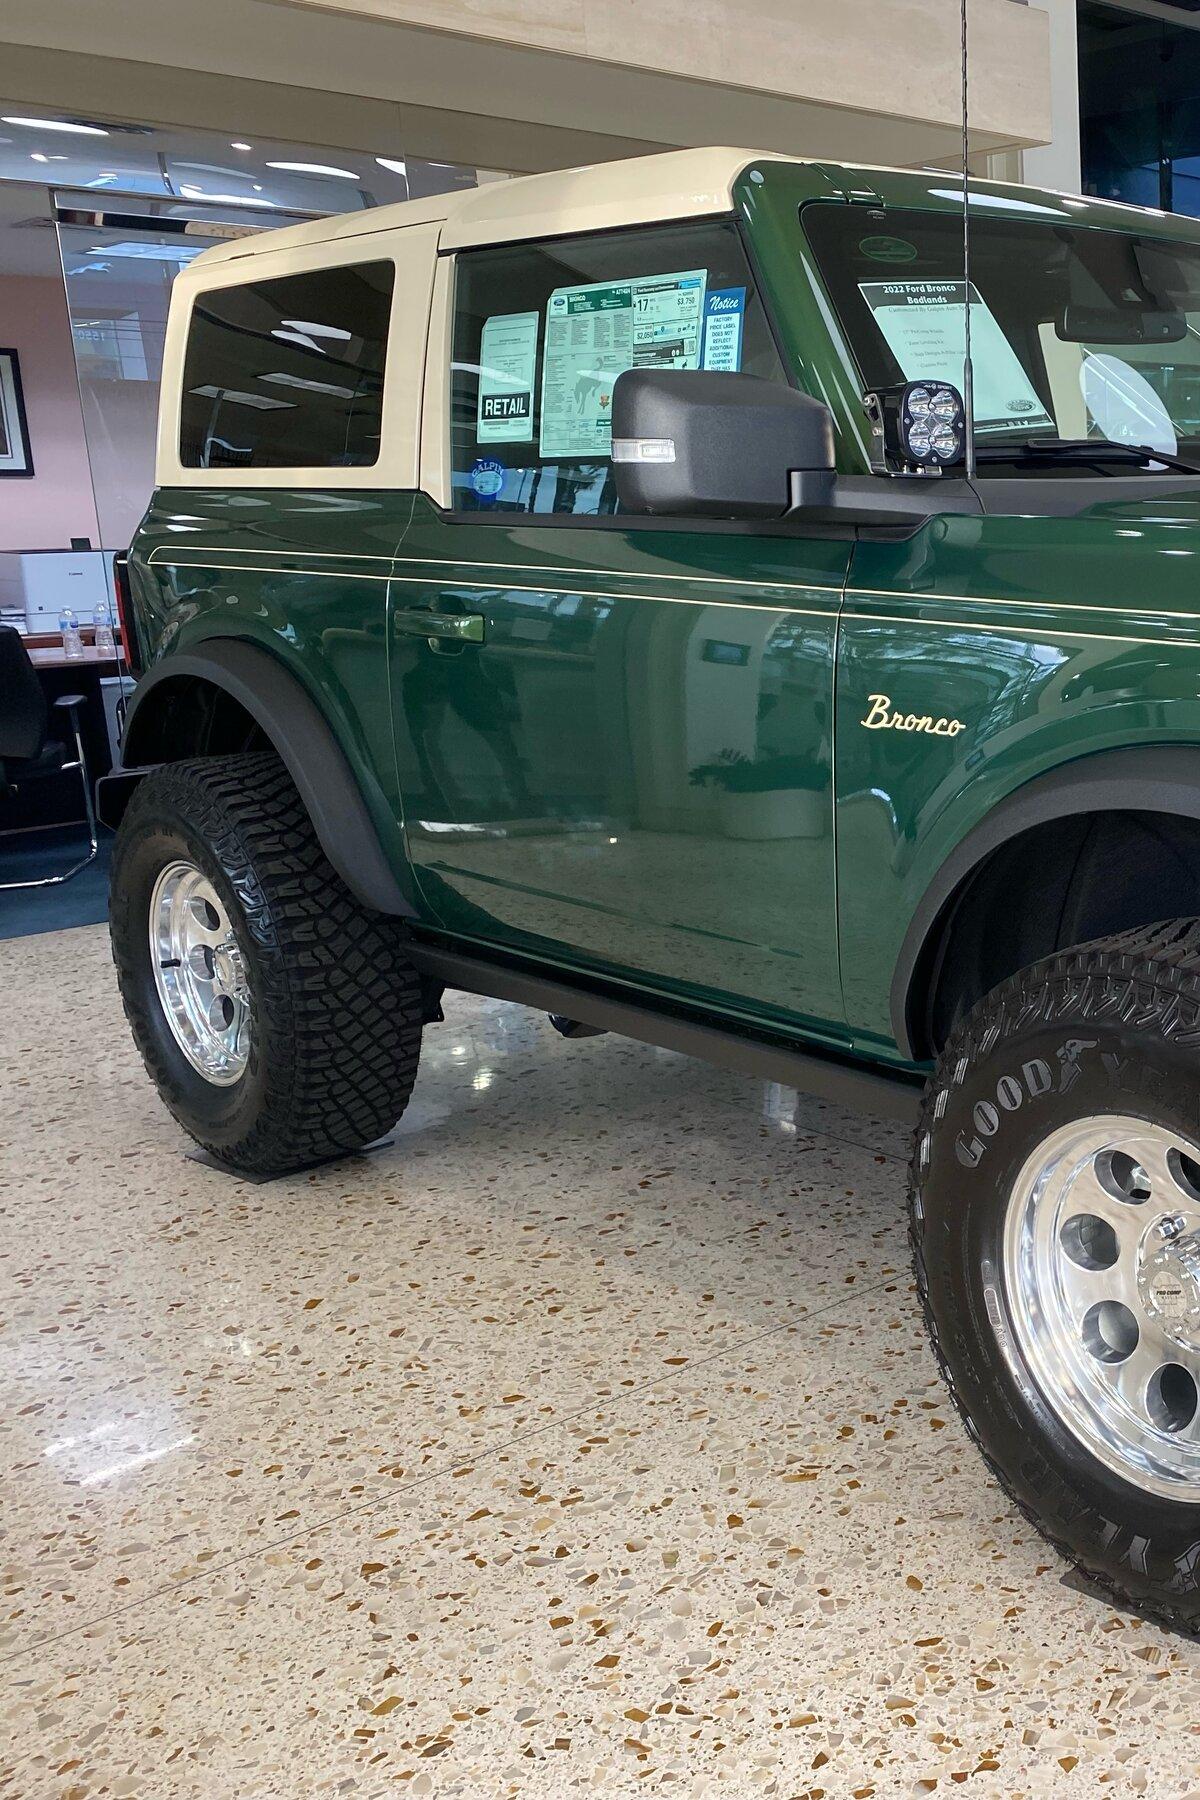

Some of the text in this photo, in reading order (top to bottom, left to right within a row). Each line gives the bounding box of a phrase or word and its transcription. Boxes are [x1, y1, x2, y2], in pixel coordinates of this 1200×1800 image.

[882, 284, 956, 294] 2022 Ford Bronco
[637, 299, 649, 312] 17
[710, 295, 739, 311] Notice
[907, 296, 948, 304] Badlands
[485, 397, 526, 416] RETAIL
[471, 462, 504, 478] GALPIN
[860, 694, 966, 737] Bronco
